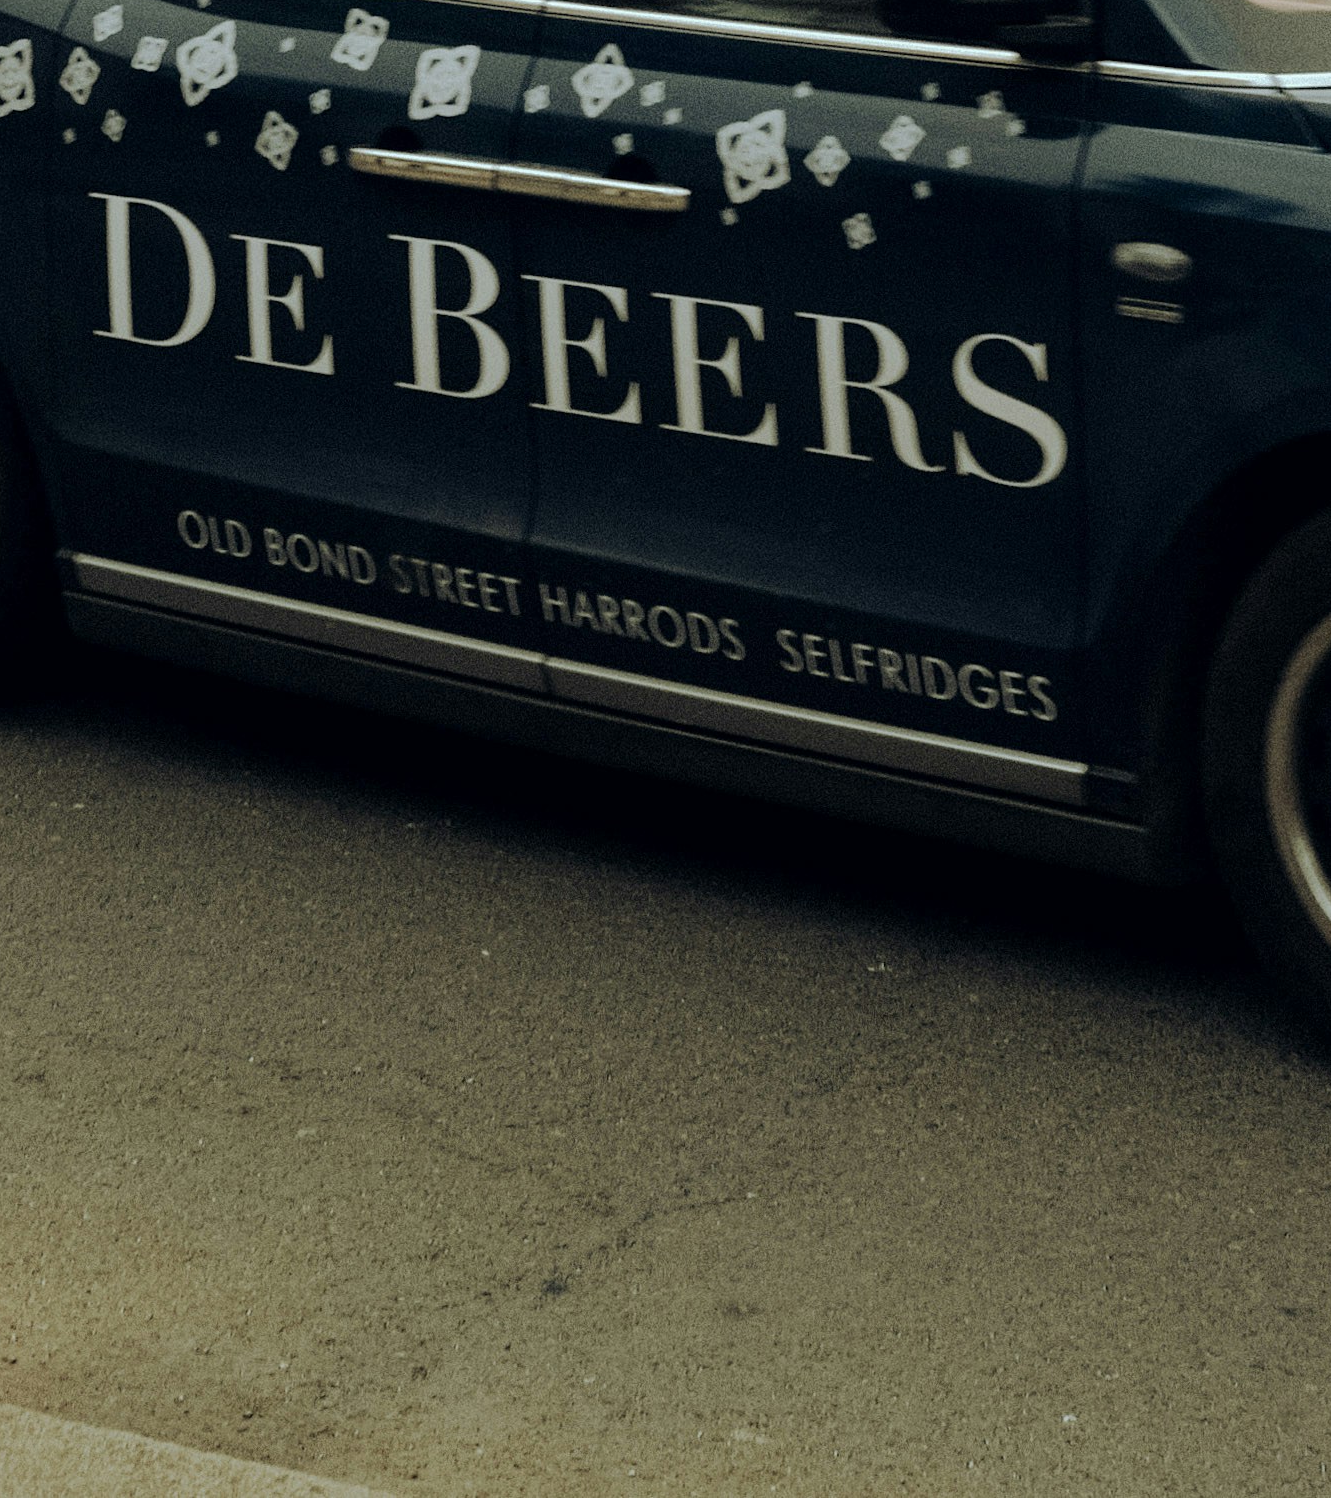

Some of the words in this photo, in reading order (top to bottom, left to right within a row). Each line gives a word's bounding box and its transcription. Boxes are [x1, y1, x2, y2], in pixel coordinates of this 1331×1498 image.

[87, 191, 336, 376] DE
[386, 233, 1068, 489] BEERS
[177, 510, 252, 560] OLD
[263, 526, 378, 586] BOND
[389, 553, 522, 619] STREET
[539, 583, 747, 663] HARRODS
[777, 628, 1060, 723] SELFRIDGES
